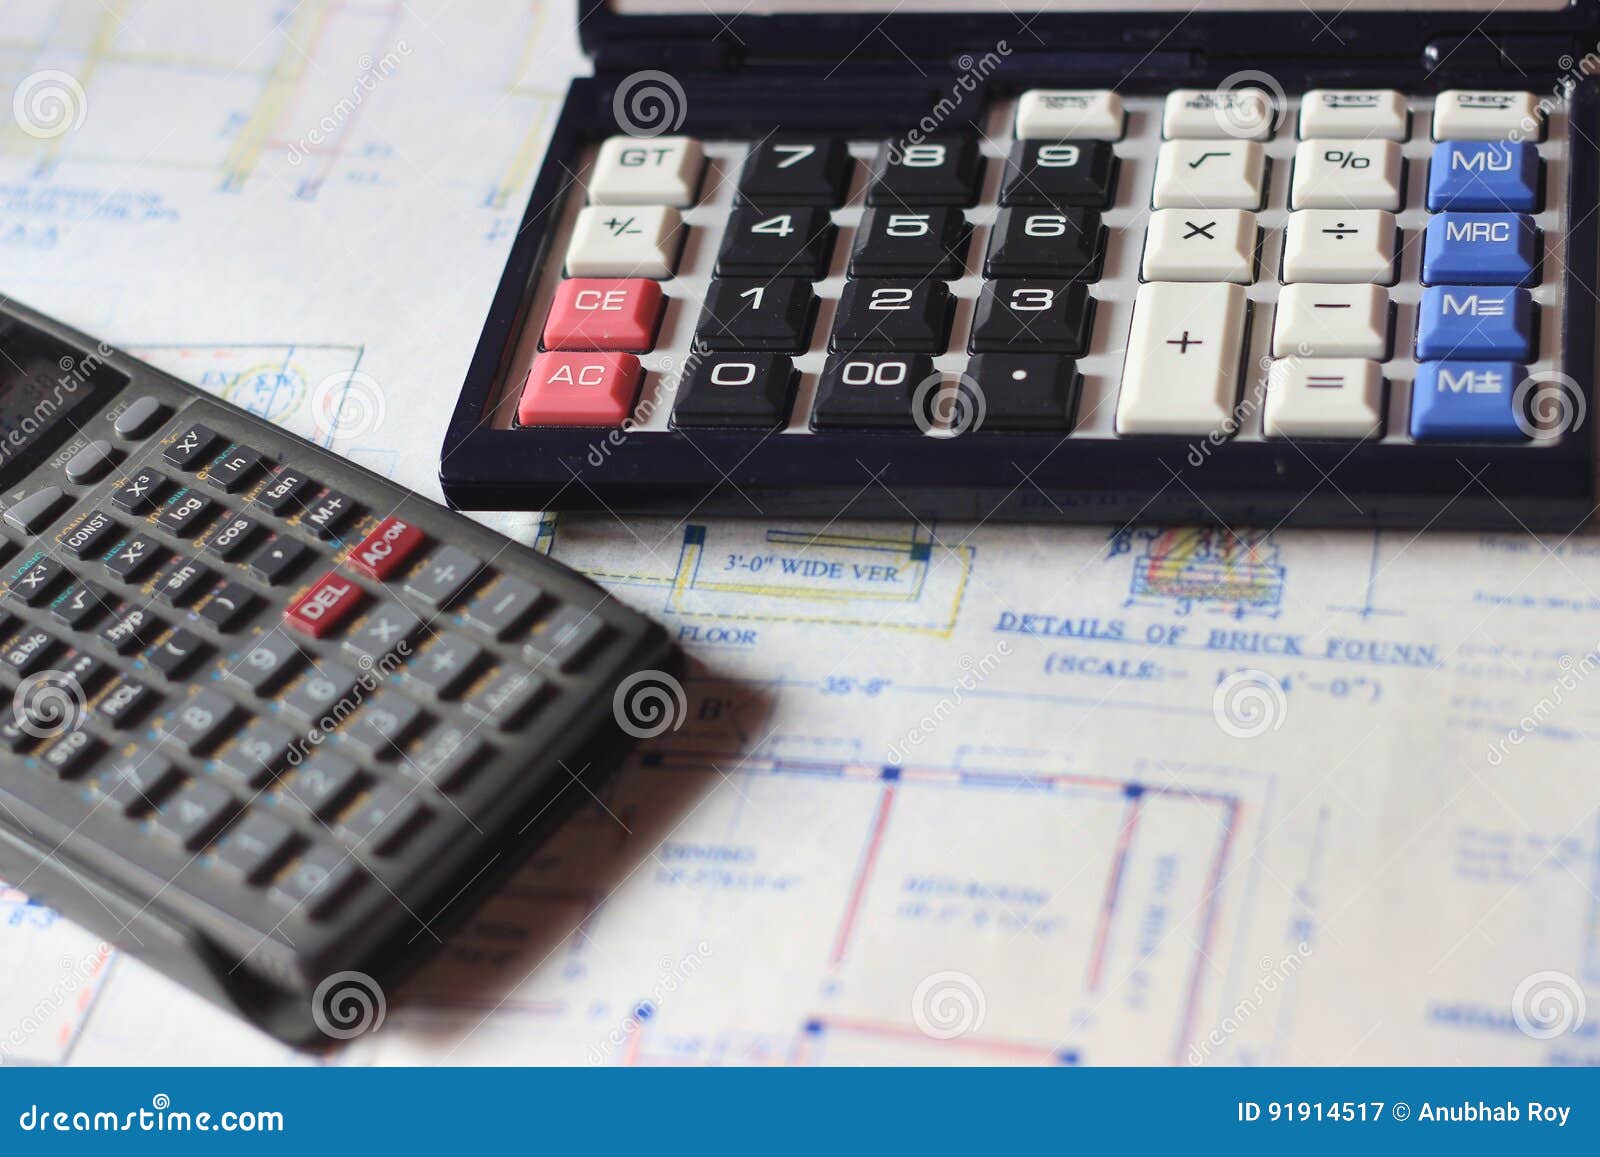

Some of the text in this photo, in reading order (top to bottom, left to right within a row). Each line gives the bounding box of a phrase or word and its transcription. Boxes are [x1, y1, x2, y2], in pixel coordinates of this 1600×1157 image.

[1322, 94, 1381, 103] CHECK
[1457, 94, 1516, 103] CHECK
[619, 148, 673, 167] GT
[773, 144, 815, 168] 7
[902, 144, 947, 168] 8
[1037, 144, 1080, 168] 9
[1452, 151, 1513, 172] MU
[751, 214, 794, 237] 4
[886, 214, 931, 237] 5
[1024, 214, 1067, 237] 6
[1446, 222, 1511, 242] MRC
[574, 289, 628, 311] CE
[739, 287, 766, 310] 1
[869, 288, 913, 310] 2
[1010, 288, 1055, 311] 3
[546, 365, 606, 386] AC
[711, 362, 757, 386] 0
[841, 361, 907, 386] 00
[50, 439, 88, 470] MODE
[266, 475, 298, 500] tan
[169, 497, 202, 521] log
[311, 497, 342, 525] M+
[68, 512, 110, 548] CONST
[216, 518, 249, 546] cos
[168, 565, 196, 590] sin
[780, 557, 844, 579] WIDE
[300, 581, 350, 620] DEL
[106, 610, 145, 641] hyp
[678, 625, 758, 645] FLOOR
[995, 610, 1126, 640] DETAILS
[1146, 623, 1188, 646] OF
[1206, 628, 1304, 657] BRICK
